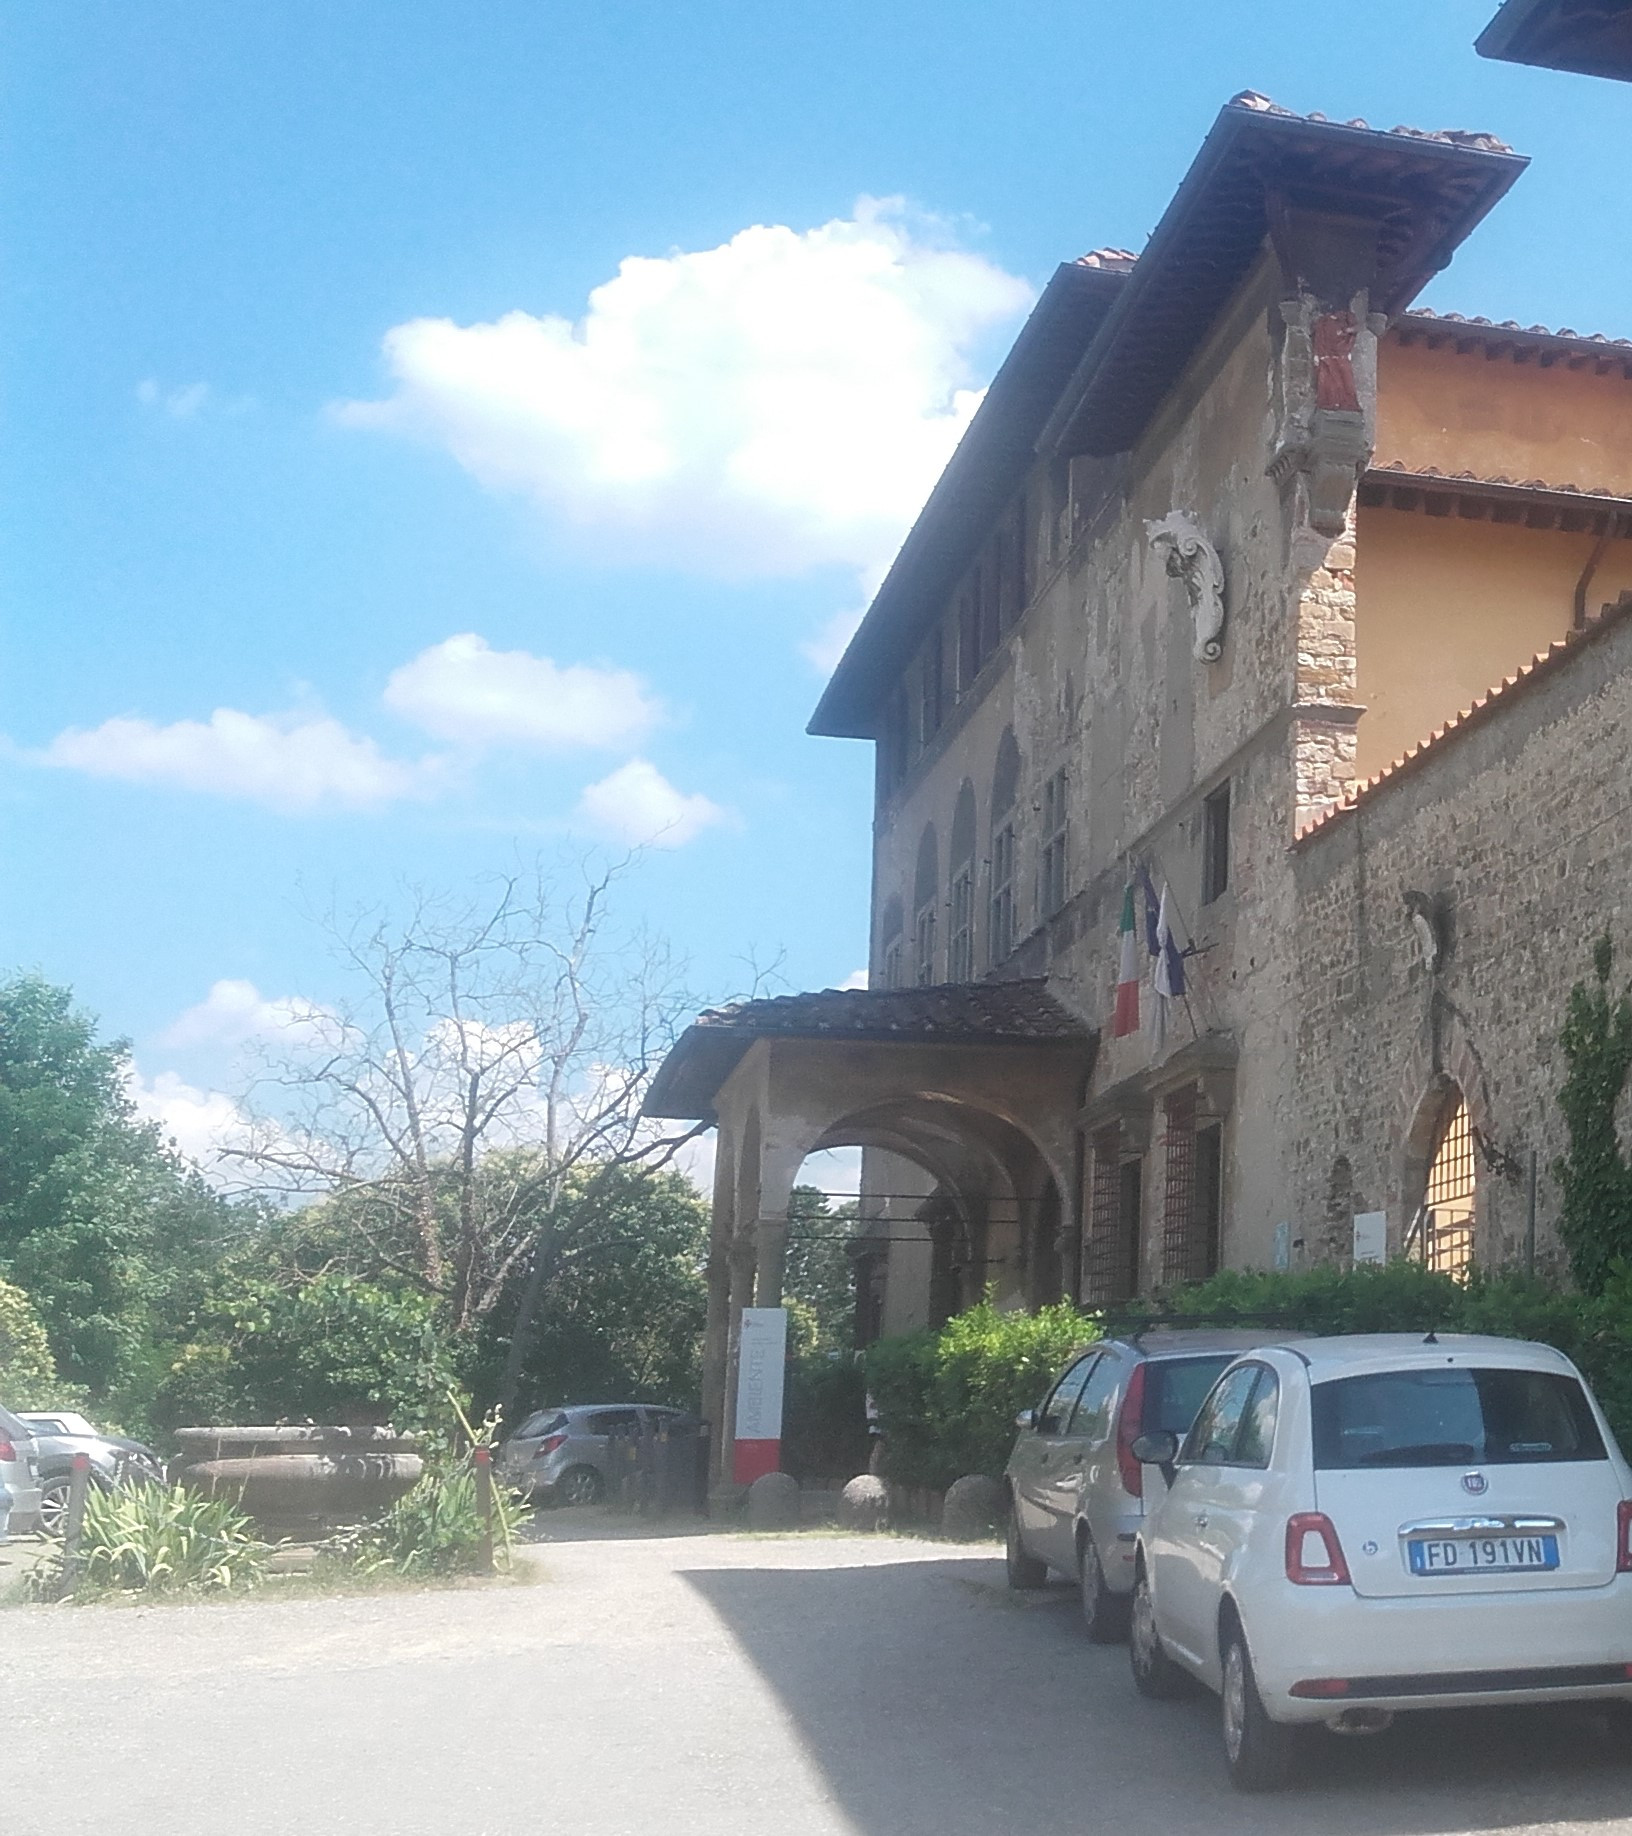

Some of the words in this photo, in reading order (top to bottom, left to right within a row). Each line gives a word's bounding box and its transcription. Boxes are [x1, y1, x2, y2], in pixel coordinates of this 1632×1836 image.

[746, 1348, 765, 1434] AMBIENTE
[1427, 1541, 1458, 1567] FD
[1469, 1537, 1542, 1565] 191VN
